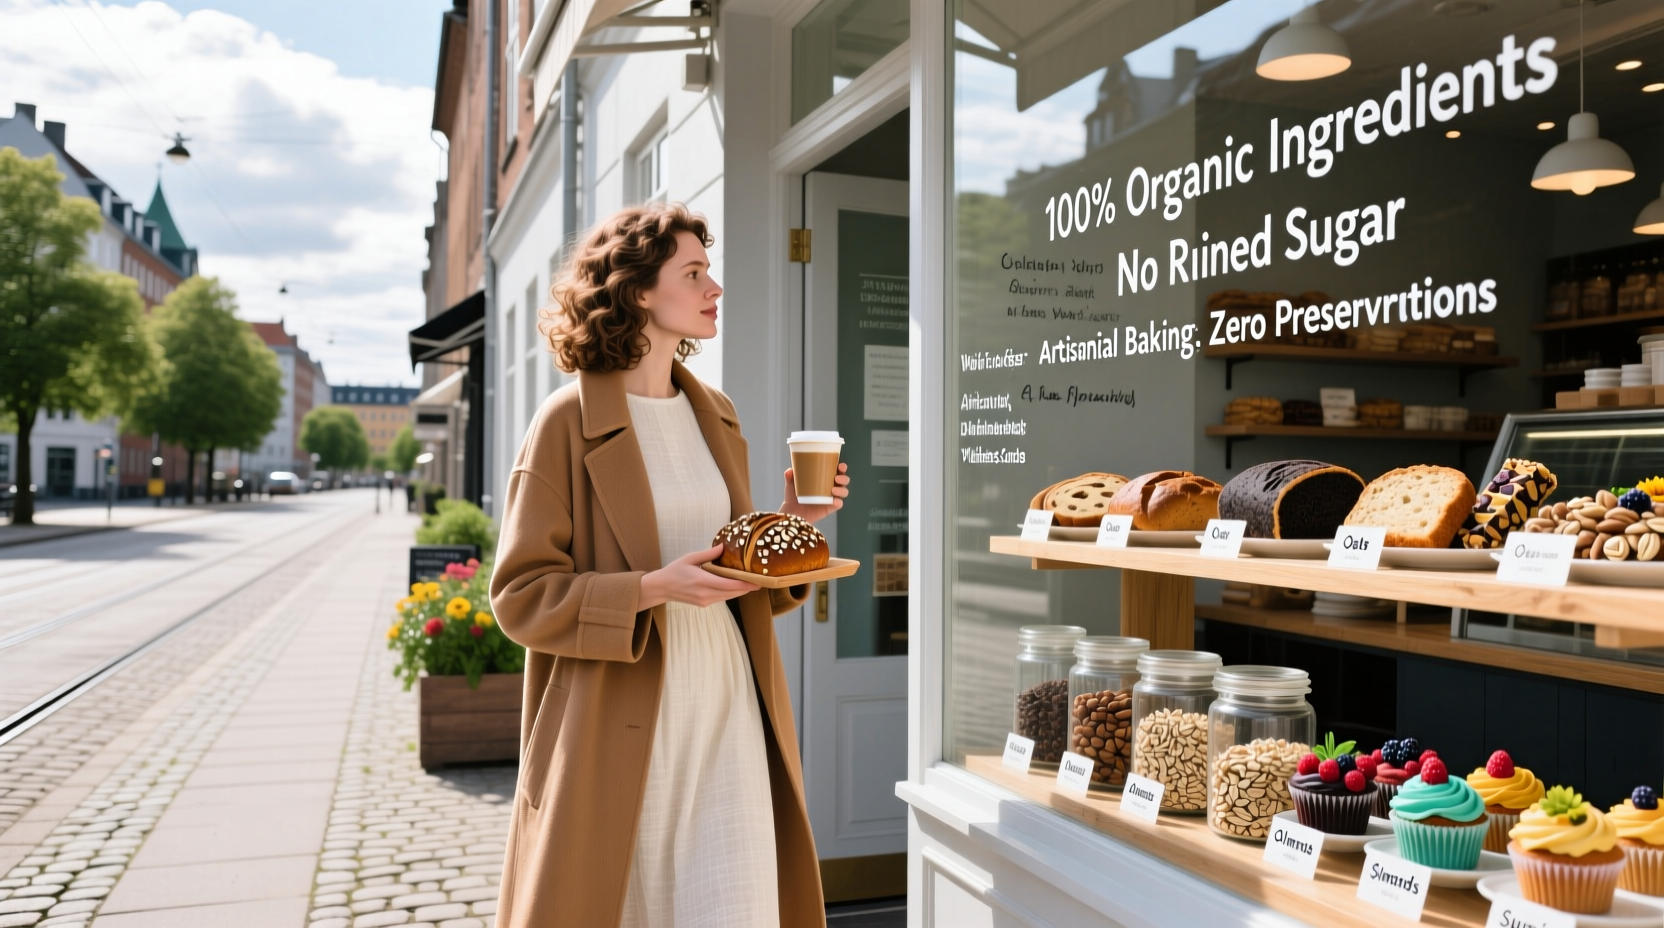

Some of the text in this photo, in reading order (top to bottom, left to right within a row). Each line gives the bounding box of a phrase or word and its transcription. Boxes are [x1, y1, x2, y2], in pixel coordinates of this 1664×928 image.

[1045, 35, 1558, 241] 100% Organic Ingredients
[1117, 249, 1158, 296] No
[1285, 197, 1406, 266] Sugar
[1209, 310, 1266, 346] Zero
